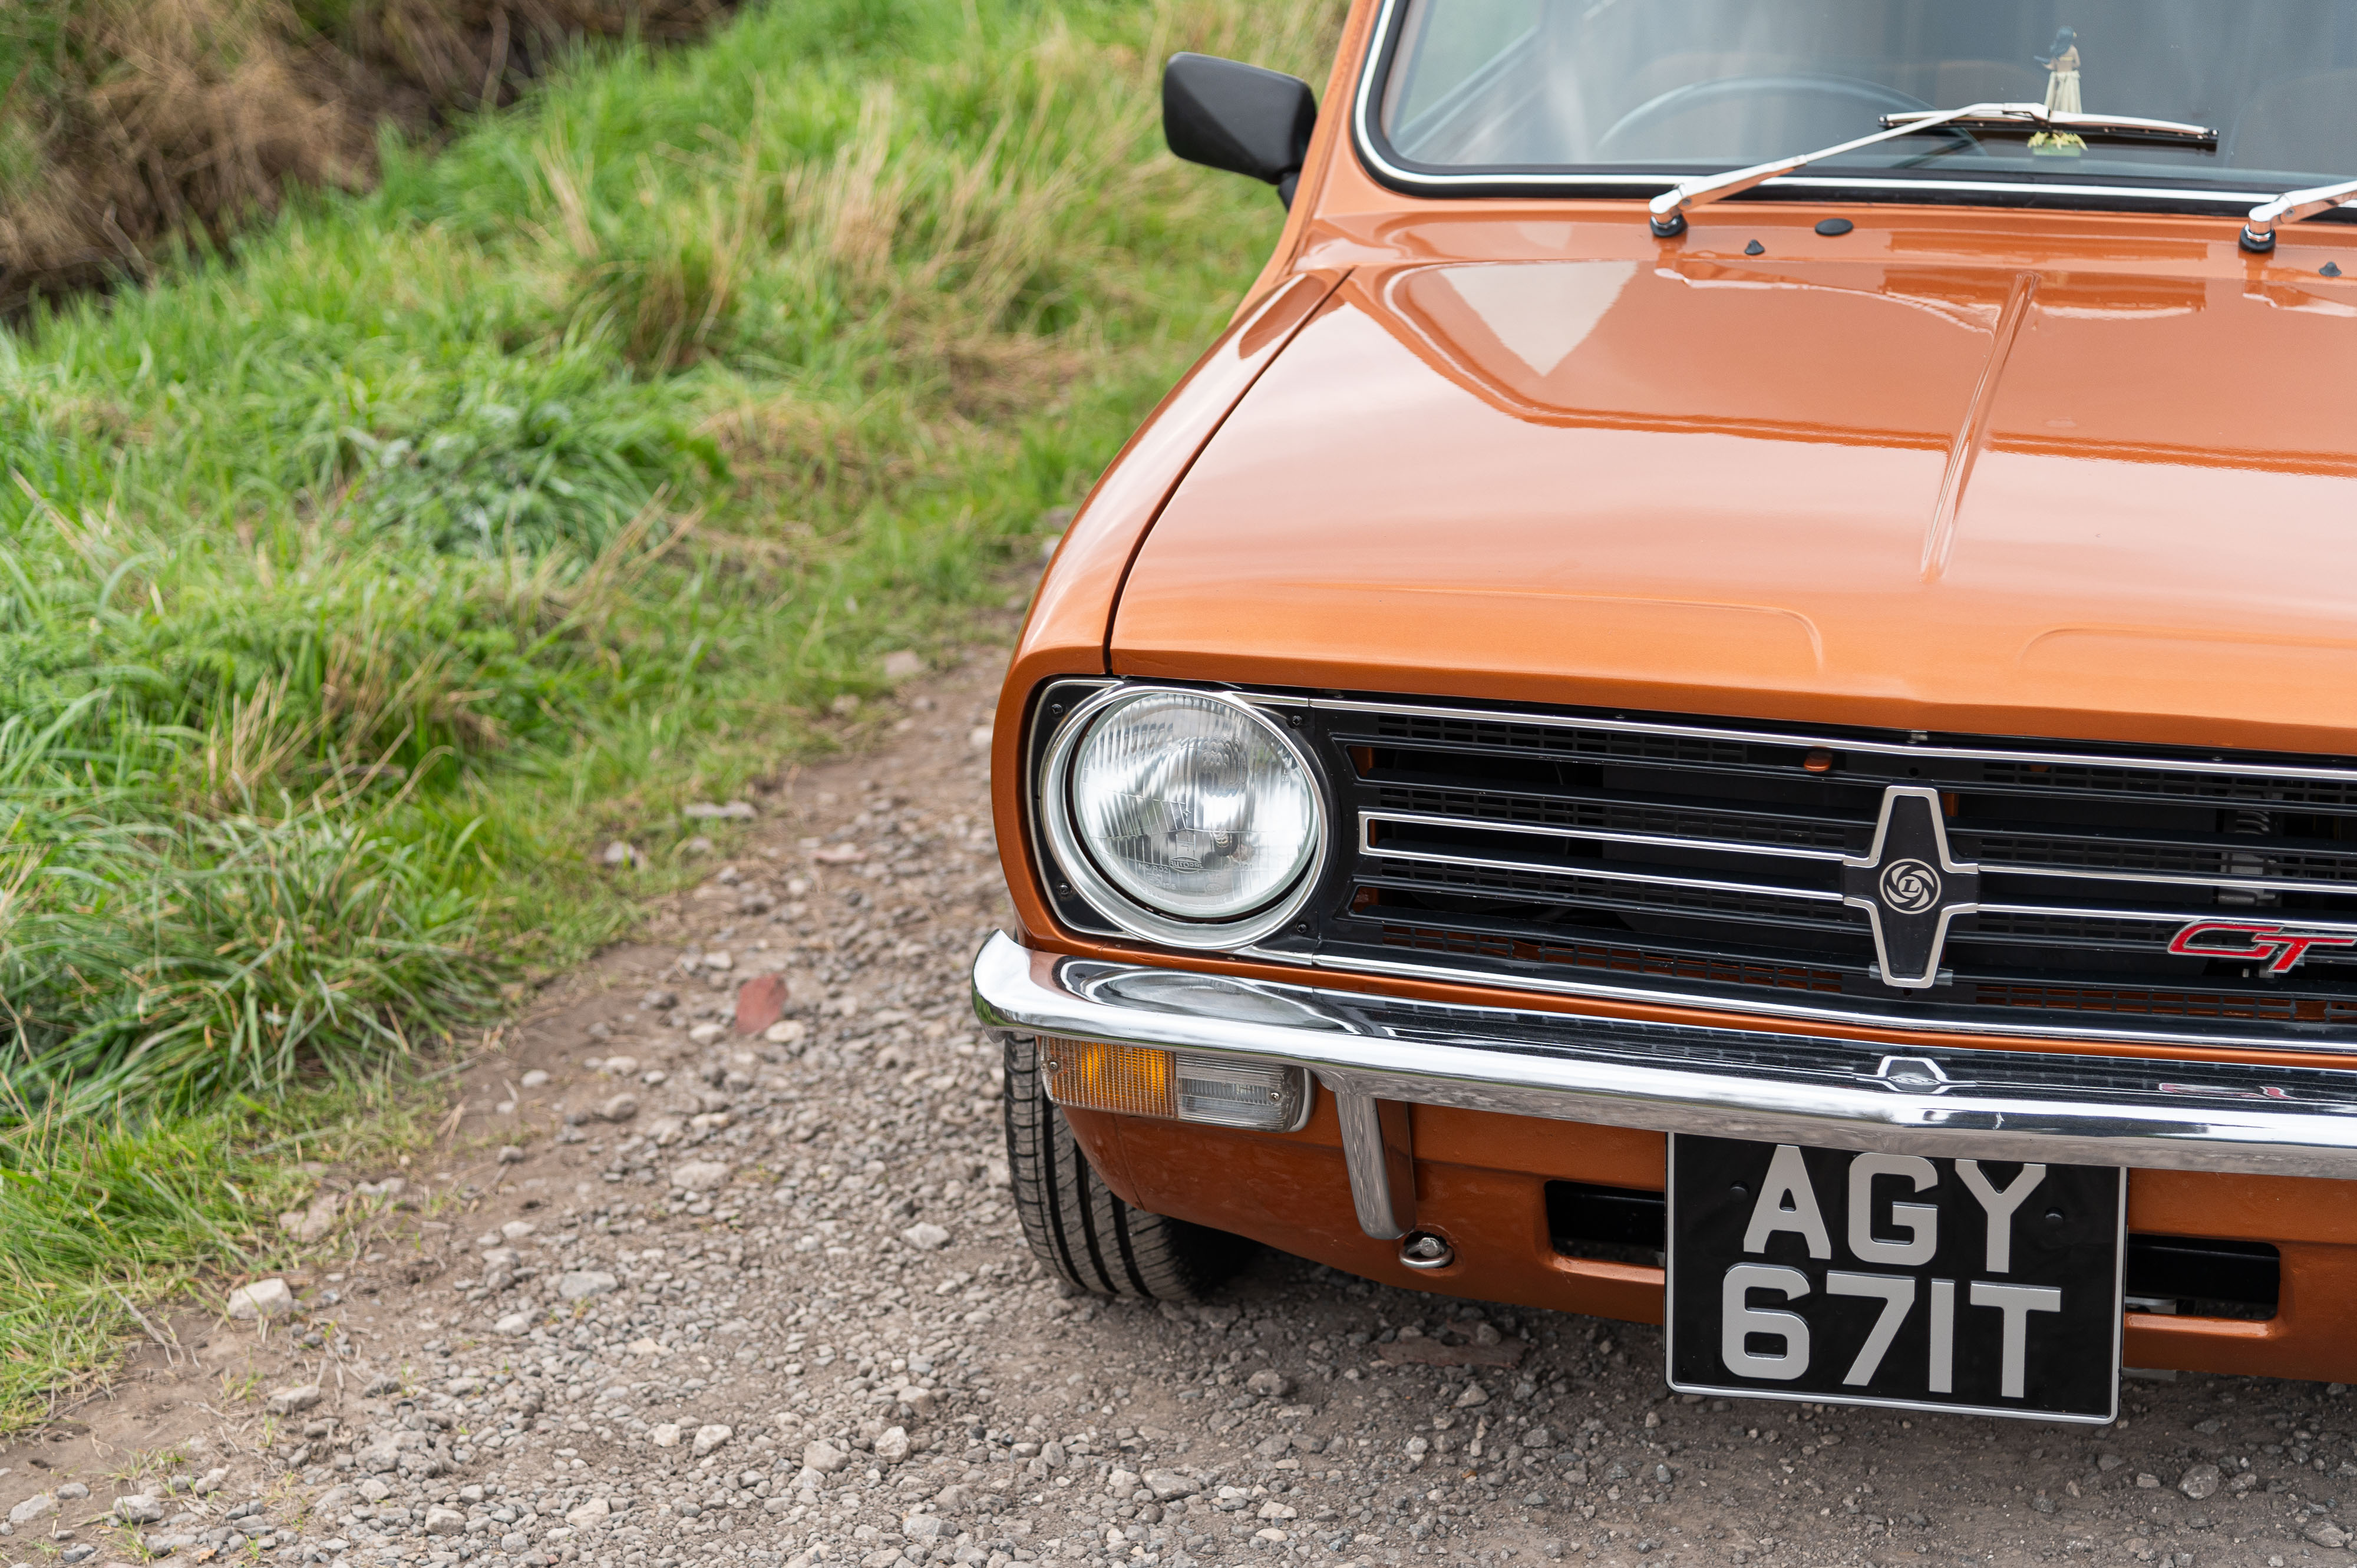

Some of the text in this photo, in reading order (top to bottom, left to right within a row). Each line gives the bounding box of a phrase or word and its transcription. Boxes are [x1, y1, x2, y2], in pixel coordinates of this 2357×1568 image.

[1901, 879, 1920, 893] L
[2167, 918, 2357, 973] GT
[1743, 1144, 2046, 1273] AGY
[1722, 1262, 2062, 1398] 671T
